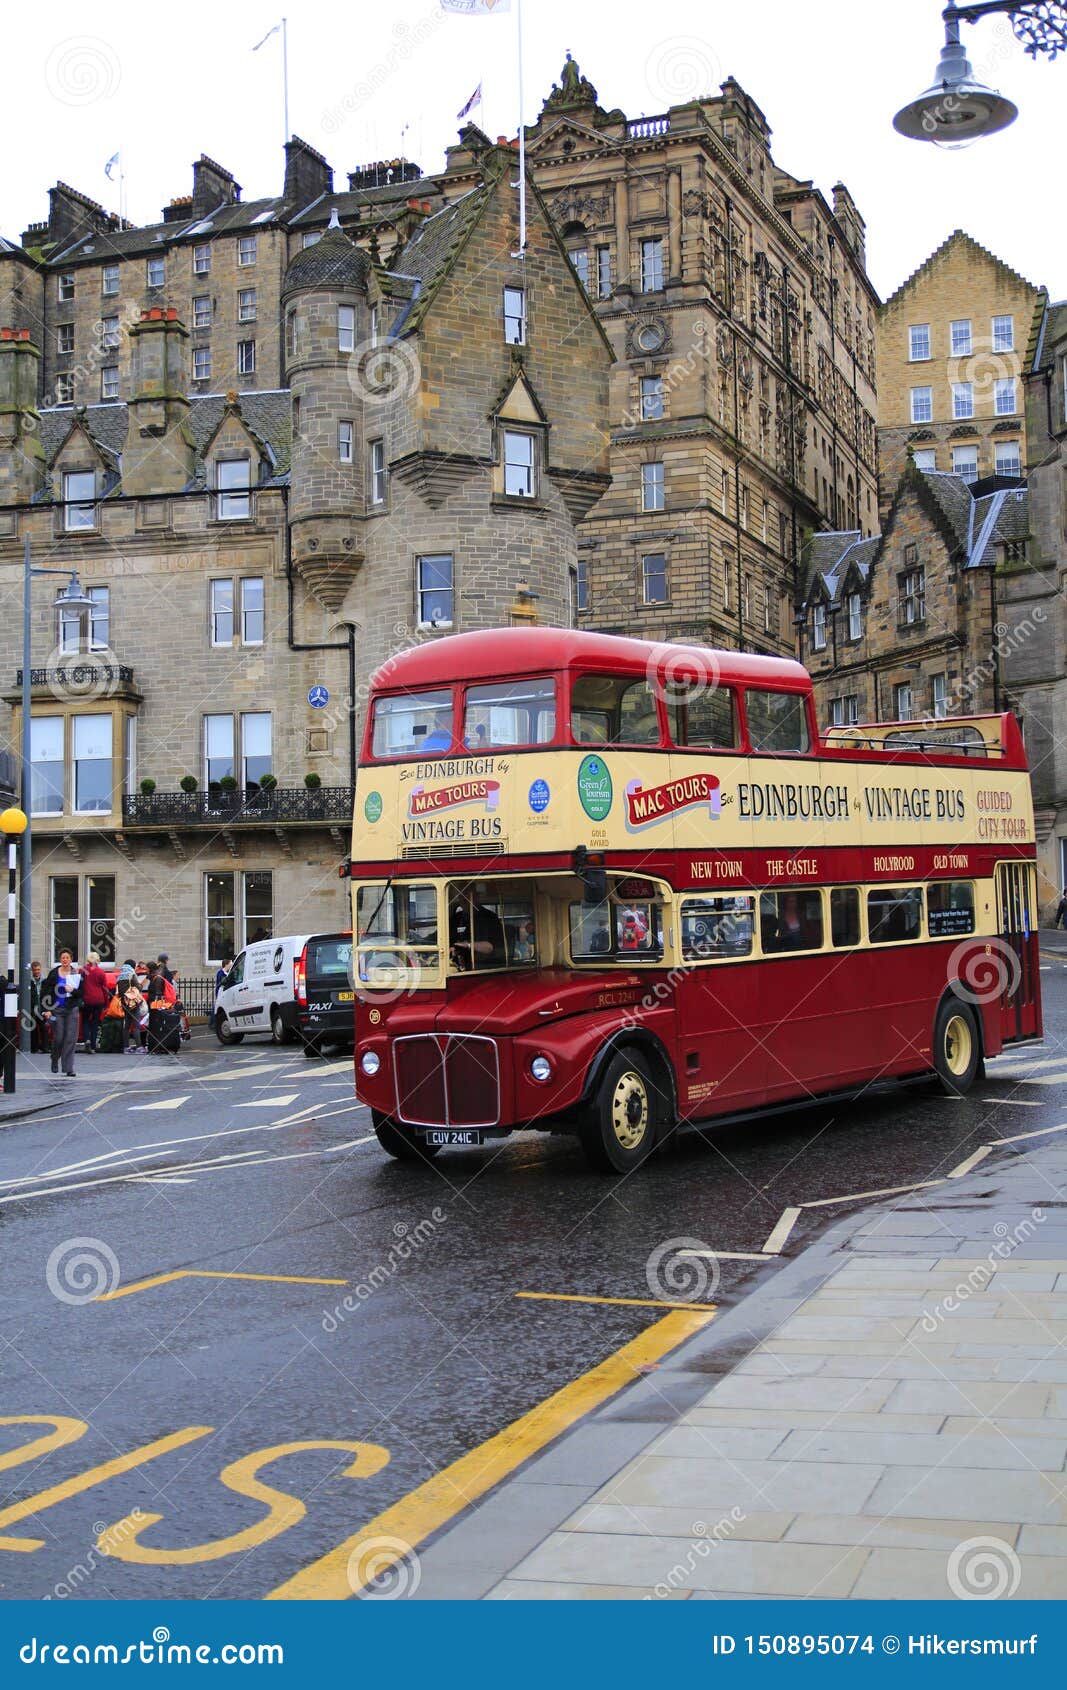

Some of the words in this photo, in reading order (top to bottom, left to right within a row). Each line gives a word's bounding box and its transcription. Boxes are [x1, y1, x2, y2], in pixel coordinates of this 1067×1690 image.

[416, 758, 495, 780] EDINBURGH
[497, 759, 510, 774] by
[579, 779, 600, 789] Green
[415, 792, 443, 812] MAC
[446, 781, 487, 803] TOURS
[586, 788, 610, 798] Tourism
[633, 790, 664, 820] MAC
[666, 776, 709, 806] TOURS
[976, 790, 1012, 812] GUIDED
[720, 792, 734, 807] See
[738, 783, 849, 820] EDINBURGH
[864, 787, 932, 820] VINTAGE
[935, 789, 965, 821] BUS
[402, 819, 465, 841] VINTAGE
[471, 817, 502, 837] BUS
[591, 830, 606, 838] GOLD
[978, 817, 999, 838] CITY
[1001, 818, 1027, 838] TOUR
[589, 839, 610, 847] AWARD
[690, 862, 713, 879] NEW
[714, 860, 743, 877] TOWN
[766, 860, 785, 876] THE
[786, 859, 818, 875] CASTLE
[873, 856, 915, 872] HOLYROOD
[933, 855, 948, 870] OLD
[949, 855, 969, 869] TOWN
[308, 1002, 333, 1011] TAXI
[432, 1132, 450, 1144] CUV
[451, 1132, 472, 1144] 241C
